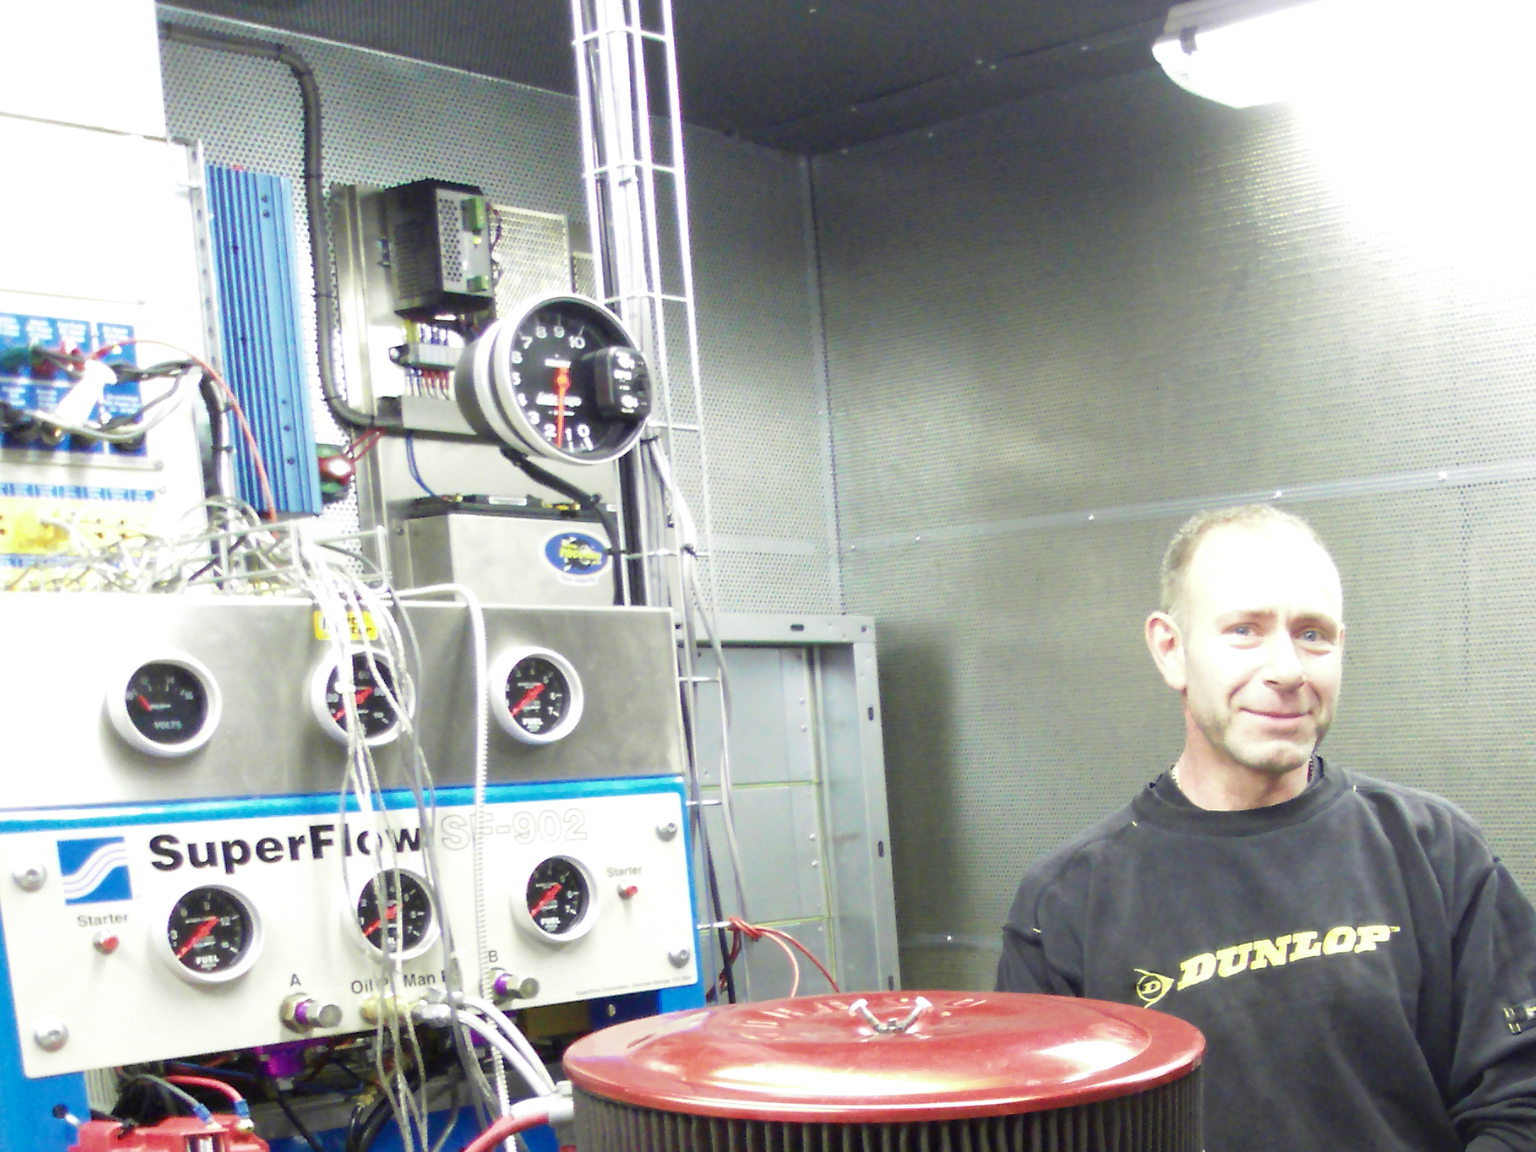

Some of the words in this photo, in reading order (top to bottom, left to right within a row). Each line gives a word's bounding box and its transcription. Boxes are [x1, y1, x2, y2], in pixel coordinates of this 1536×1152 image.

[520, 336, 533, 349] 7
[569, 335, 586, 349] 10
[527, 410, 540, 425] 3
[543, 423, 557, 438] 2
[577, 424, 590, 438] 0
[606, 865, 643, 879] Starter
[76, 911, 130, 928] Starter
[488, 951, 499, 963] B
[1177, 924, 1394, 991] DUNLOP
[289, 973, 302, 987] A
[350, 978, 374, 995] Oil
[403, 973, 436, 988] Man
